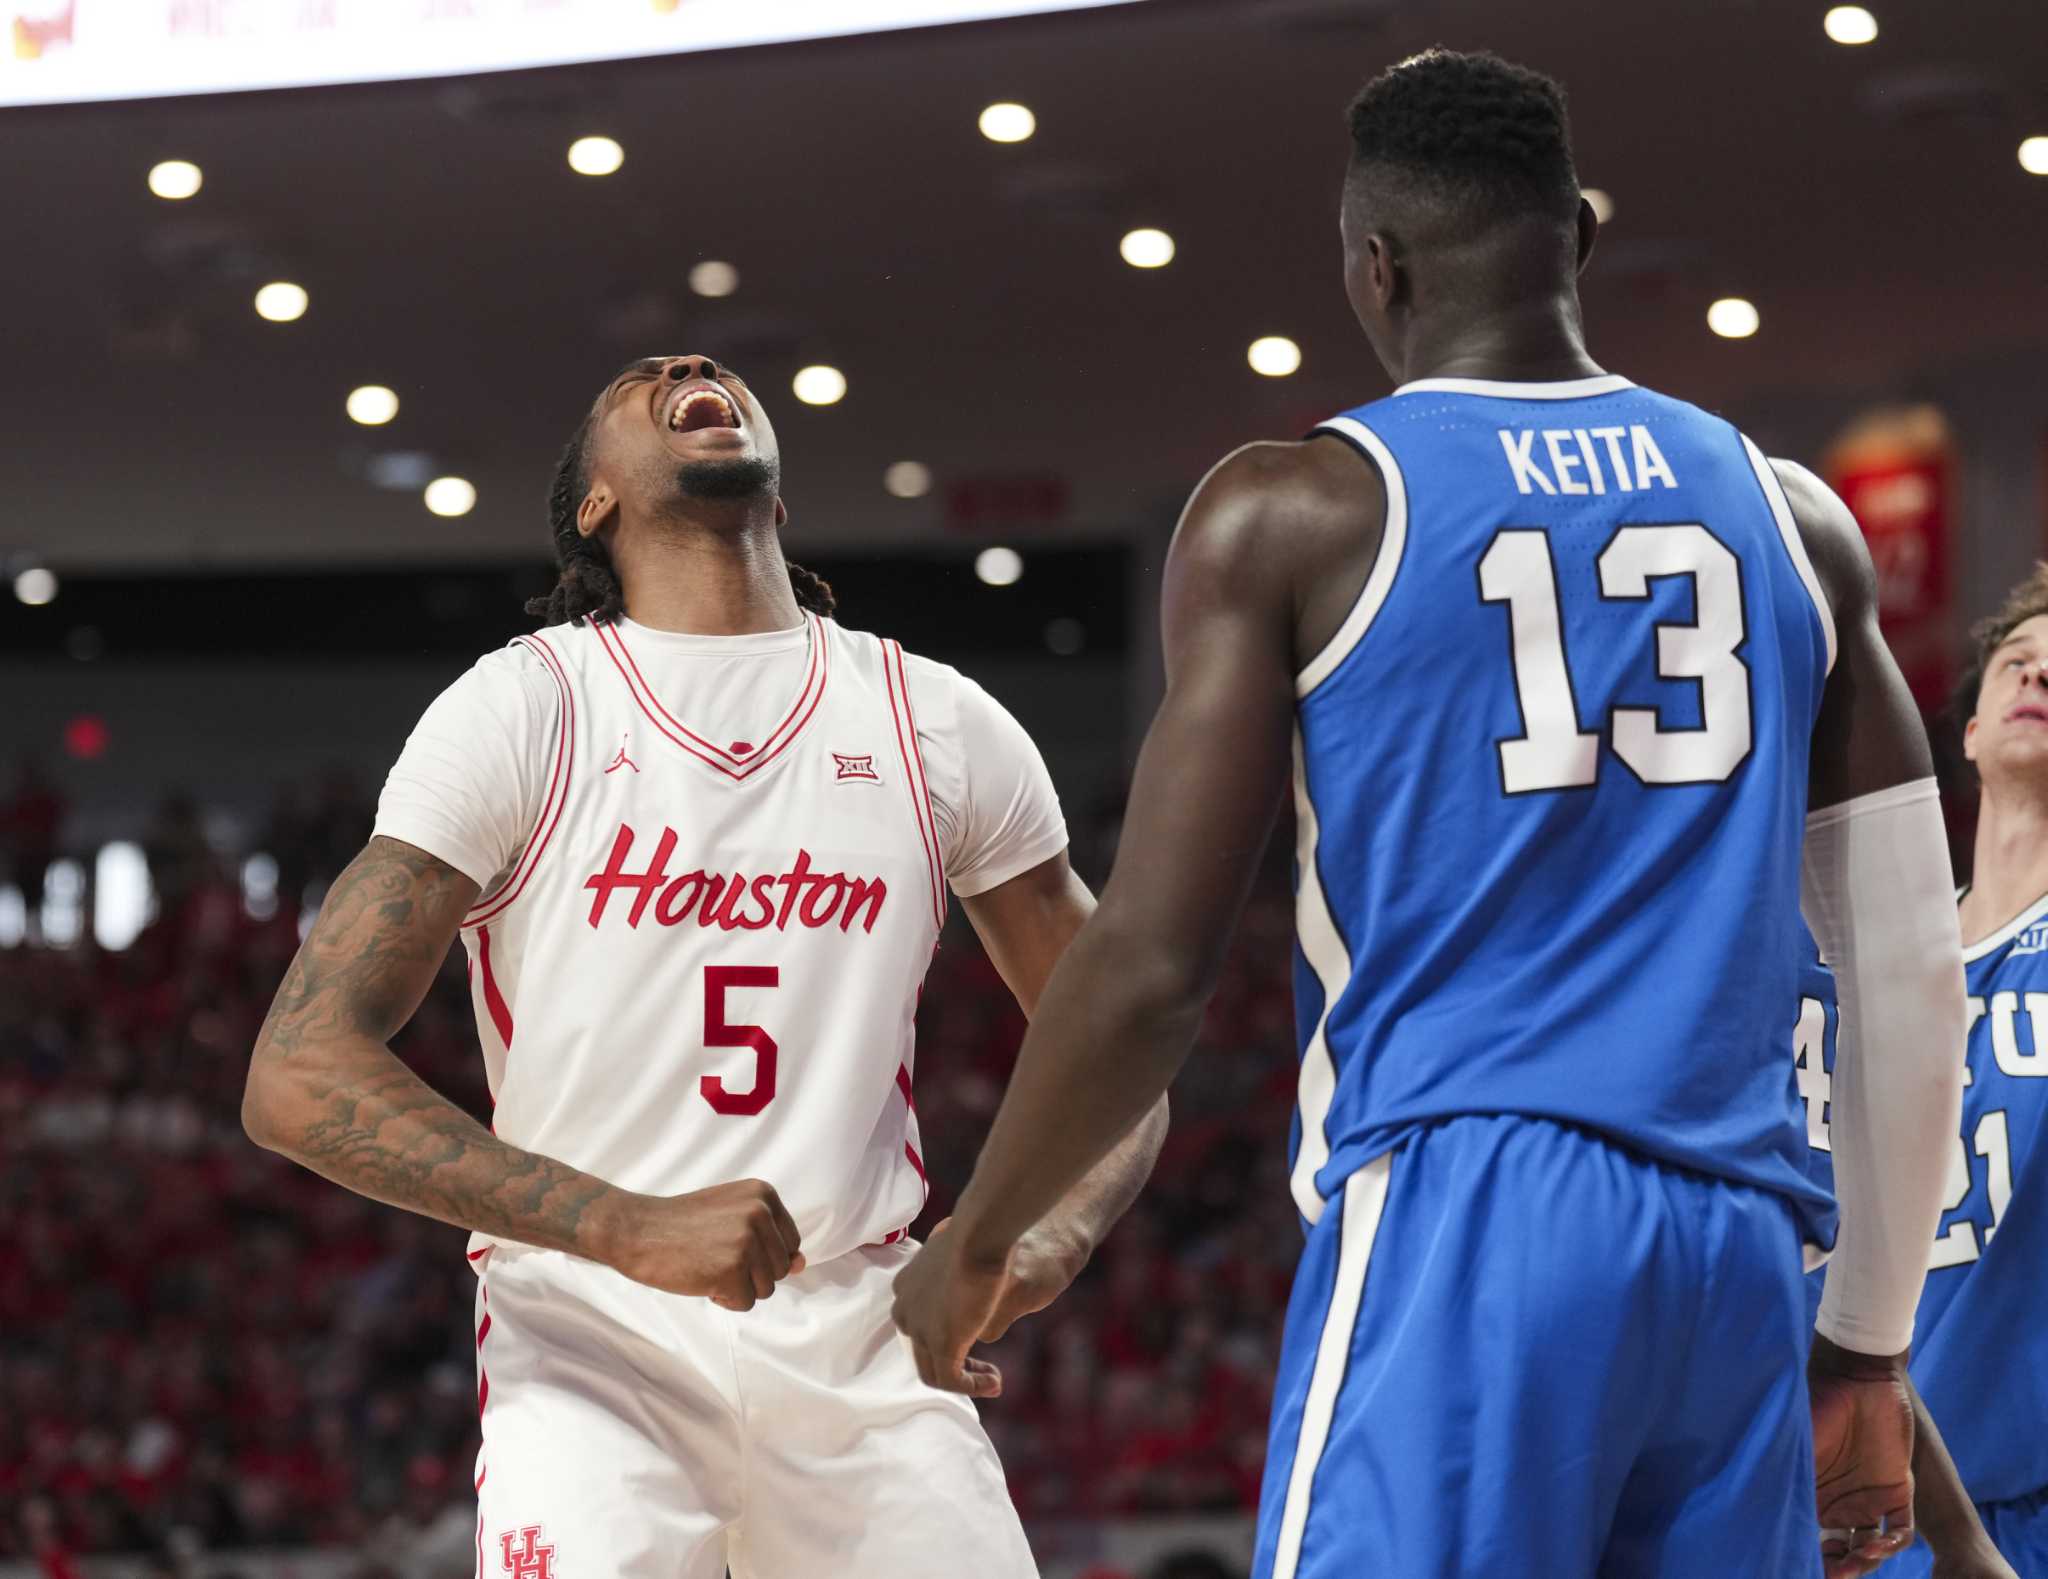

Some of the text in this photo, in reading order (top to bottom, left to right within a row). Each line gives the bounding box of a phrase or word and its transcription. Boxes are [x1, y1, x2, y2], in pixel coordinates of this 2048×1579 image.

[1498, 424, 1678, 495] KEITA
[1477, 523, 1754, 797] 13
[583, 823, 887, 934] Houston
[700, 966, 779, 1116] 5
[1792, 997, 1840, 1151] 4
